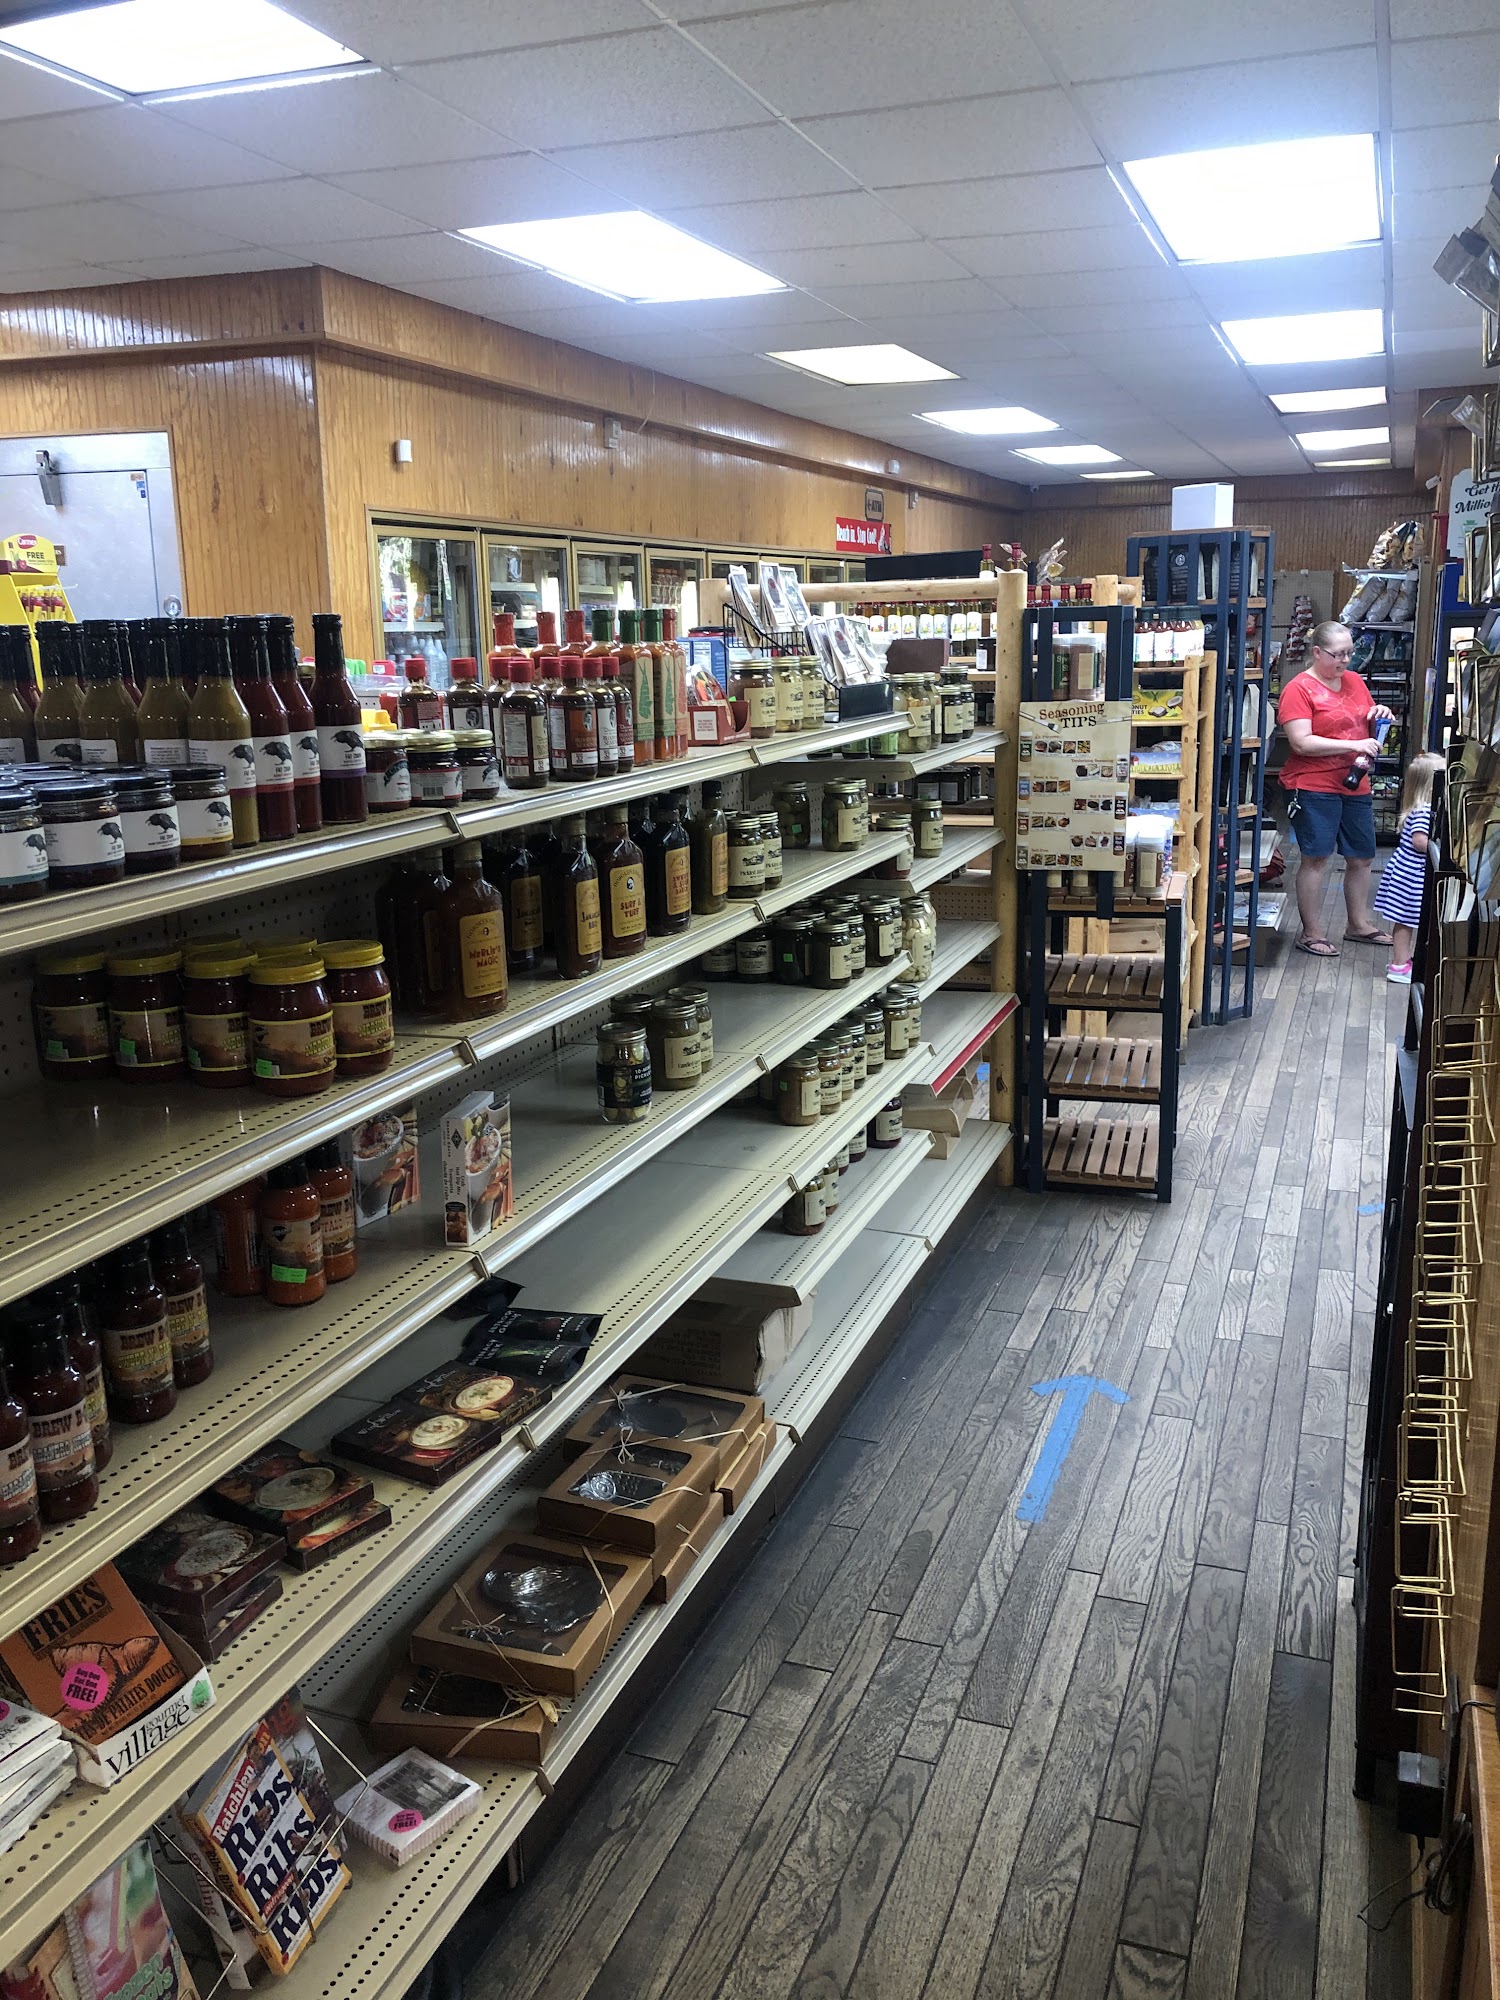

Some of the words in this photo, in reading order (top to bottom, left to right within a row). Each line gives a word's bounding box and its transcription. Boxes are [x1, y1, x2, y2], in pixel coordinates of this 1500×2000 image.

[1465, 485, 1490, 496] Get
[1455, 499, 1491, 513] Millio
[26, 551, 45, 559] FREE
[1039, 703, 1105, 720] Seasoning
[1060, 716, 1097, 728] TIPS
[620, 899, 637, 911] SURF
[624, 908, 640, 918] TURF
[32, 1413, 74, 1438] BREW
[21, 1577, 109, 1650] FRIES
[65, 1683, 99, 1704] FREE!
[110, 1682, 149, 1721] PATATES
[148, 1659, 181, 1692] DOUCES
[146, 1694, 186, 1732] gourmet
[105, 1703, 191, 1775] village
[213, 1763, 257, 1840] Raichlen
[393, 1819, 417, 1830] FREE!
